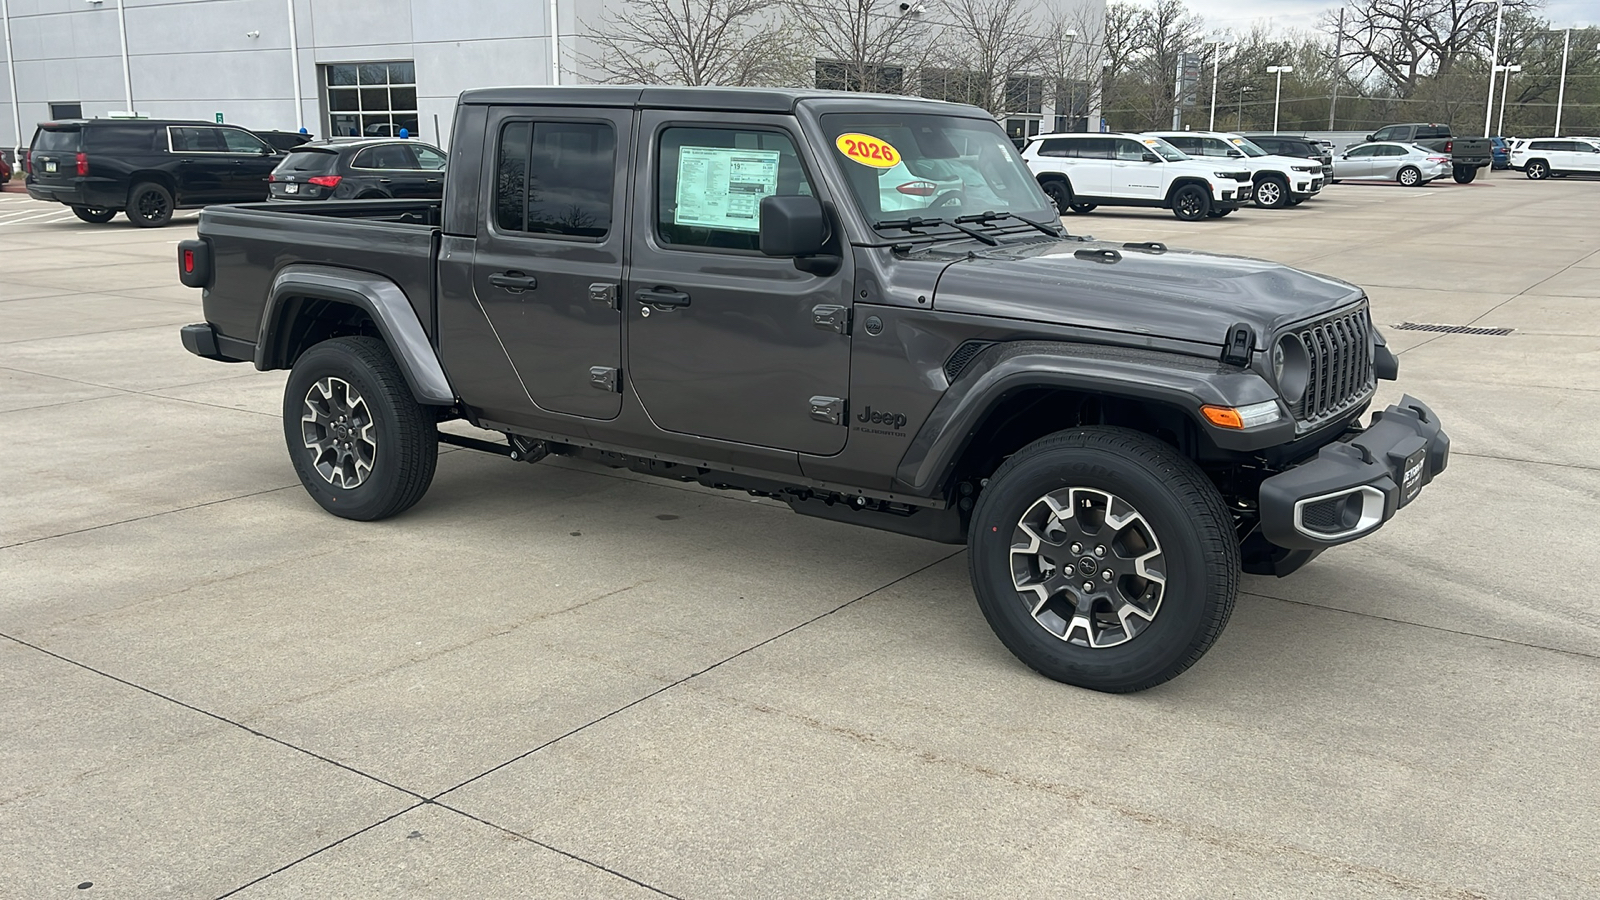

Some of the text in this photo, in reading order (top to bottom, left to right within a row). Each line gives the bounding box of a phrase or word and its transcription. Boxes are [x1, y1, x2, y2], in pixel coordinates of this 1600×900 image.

[845, 139, 894, 161] 2026
[857, 405, 907, 430] Jeep
[860, 427, 907, 438] GLADIATOR
